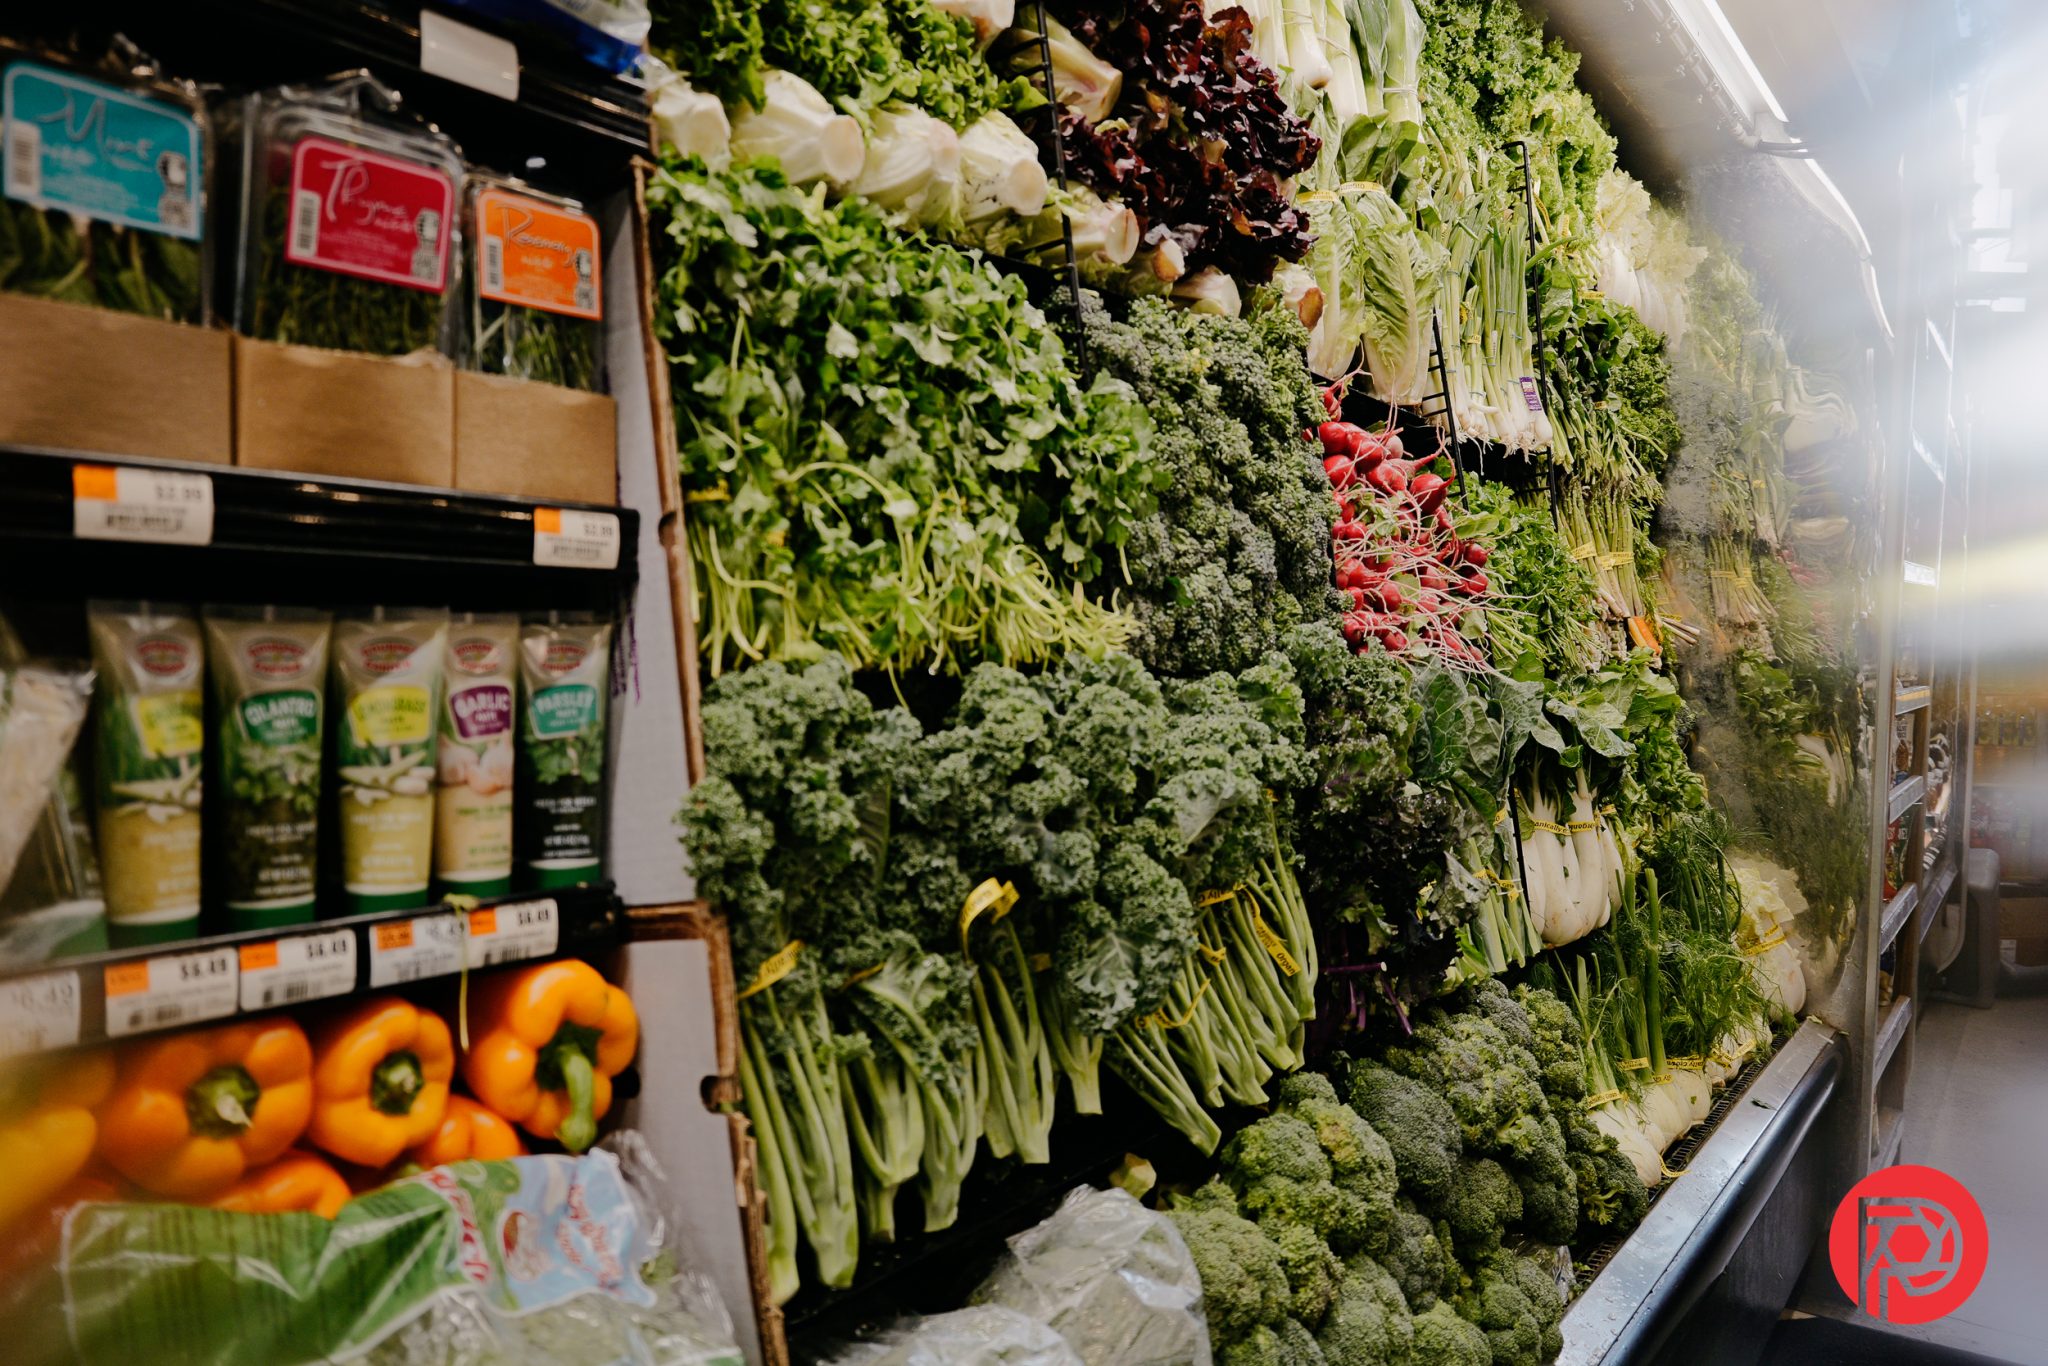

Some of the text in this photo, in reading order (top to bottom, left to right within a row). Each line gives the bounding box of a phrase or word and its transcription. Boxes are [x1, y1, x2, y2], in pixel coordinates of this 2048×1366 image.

[245, 697, 316, 726] CILANTRO
[454, 692, 510, 718] GARLIC
[535, 690, 595, 714] PARSLEY
[518, 909, 550, 926] $6.49
[307, 938, 348, 959] $6.49
[180, 957, 229, 981] $6.49
